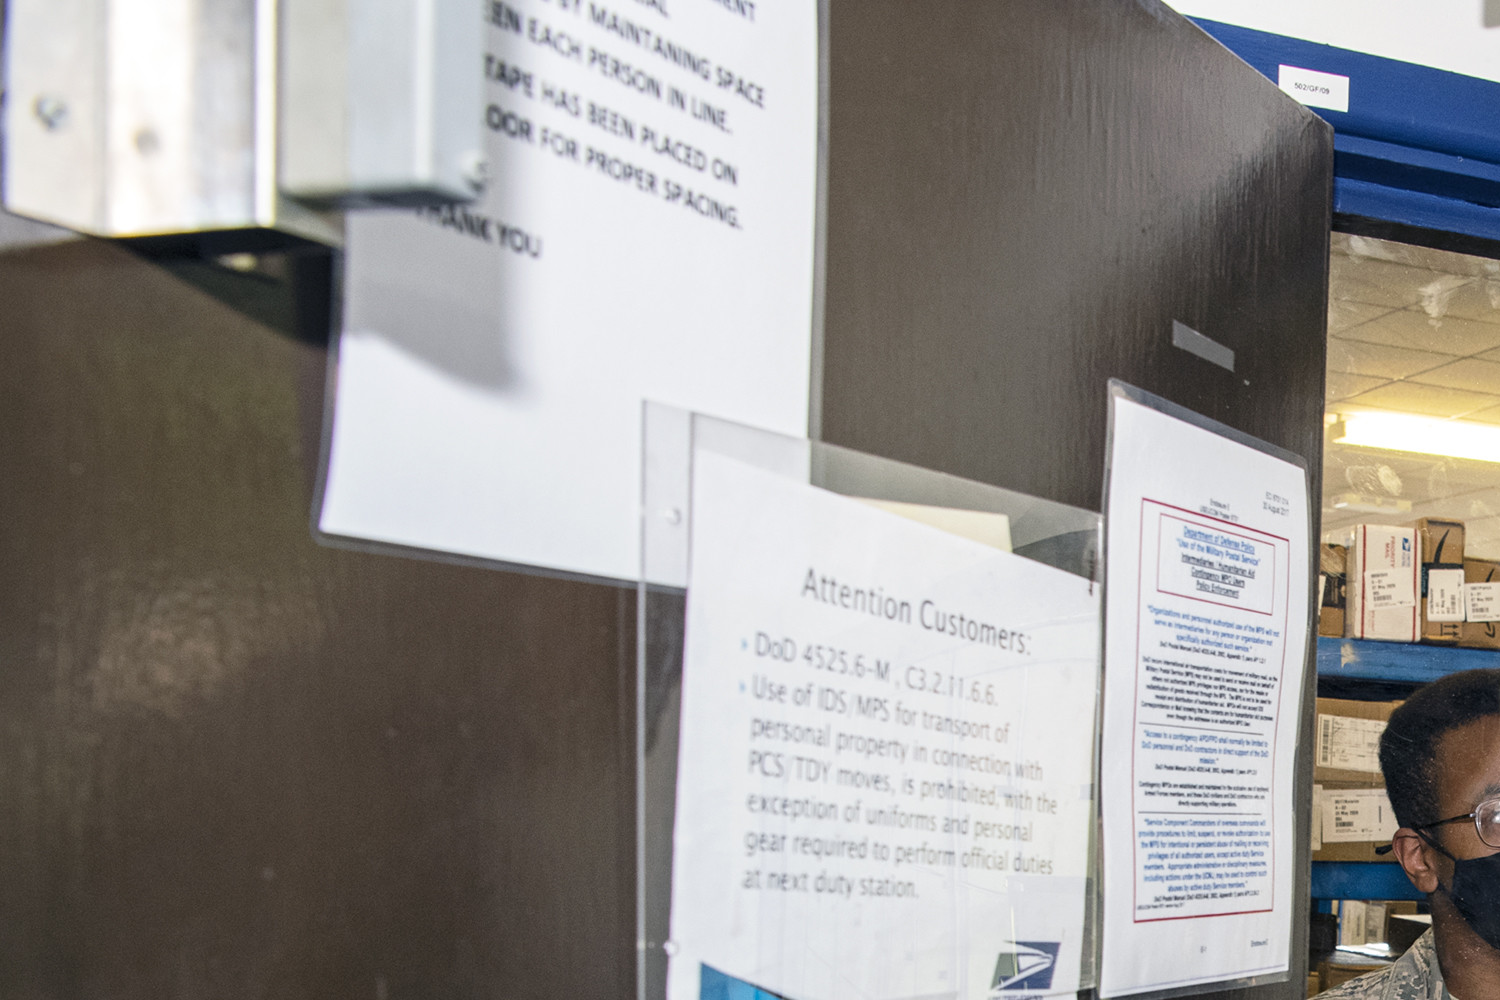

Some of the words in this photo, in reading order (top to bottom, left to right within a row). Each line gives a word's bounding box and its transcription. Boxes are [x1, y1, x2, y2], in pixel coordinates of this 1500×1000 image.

[528, 17, 582, 60] EACH
[587, 47, 663, 99] PERSON
[668, 85, 686, 110] IN
[691, 96, 733, 134] LINE.
[589, 1, 711, 81] MAINTANING
[715, 65, 766, 109] SPACE
[484, 52, 533, 98] TAPE
[542, 82, 581, 118] HAS
[588, 102, 634, 140] BEEN
[641, 126, 707, 172] PLACED
[712, 158, 738, 185] ON
[540, 127, 579, 161] FOR
[585, 147, 657, 193] PROPER
[663, 179, 742, 230] SPACING.
[497, 221, 542, 259] YOU
[1184, 526, 1213, 542] Department
[1221, 535, 1239, 548] Defense
[1241, 541, 1255, 553] Policy
[1206, 545, 1224, 560] Military
[1225, 550, 1240, 561] Postal
[1196, 580, 1210, 591] Policy
[801, 566, 911, 625] Attention
[918, 599, 1031, 656] Customers:
[754, 630, 797, 663] DoD
[752, 674, 785, 704] Use
[792, 684, 812, 707] of
[896, 701, 918, 728] for
[921, 709, 991, 743] transport
[994, 722, 1011, 744] of
[750, 716, 831, 748] personal
[836, 731, 907, 765] property
[913, 740, 928, 764] in
[931, 746, 1012, 777] connection
[1015, 759, 1044, 781] with
[836, 767, 897, 796] moves,
[901, 776, 915, 795] is
[1003, 787, 1033, 811] with
[1037, 794, 1058, 816] the
[747, 792, 839, 822] exception
[843, 799, 862, 824] of
[865, 804, 937, 833] uniforms
[941, 813, 969, 836] and
[973, 817, 1033, 842] personal
[744, 829, 787, 857] gear
[792, 833, 868, 864] required
[873, 841, 890, 864] to
[894, 842, 956, 868] perform
[961, 848, 1009, 871] official
[1012, 852, 1054, 876] duties
[742, 868, 762, 890] at
[767, 872, 810, 893] next
[813, 870, 854, 899] duty
[860, 876, 920, 899] station.
